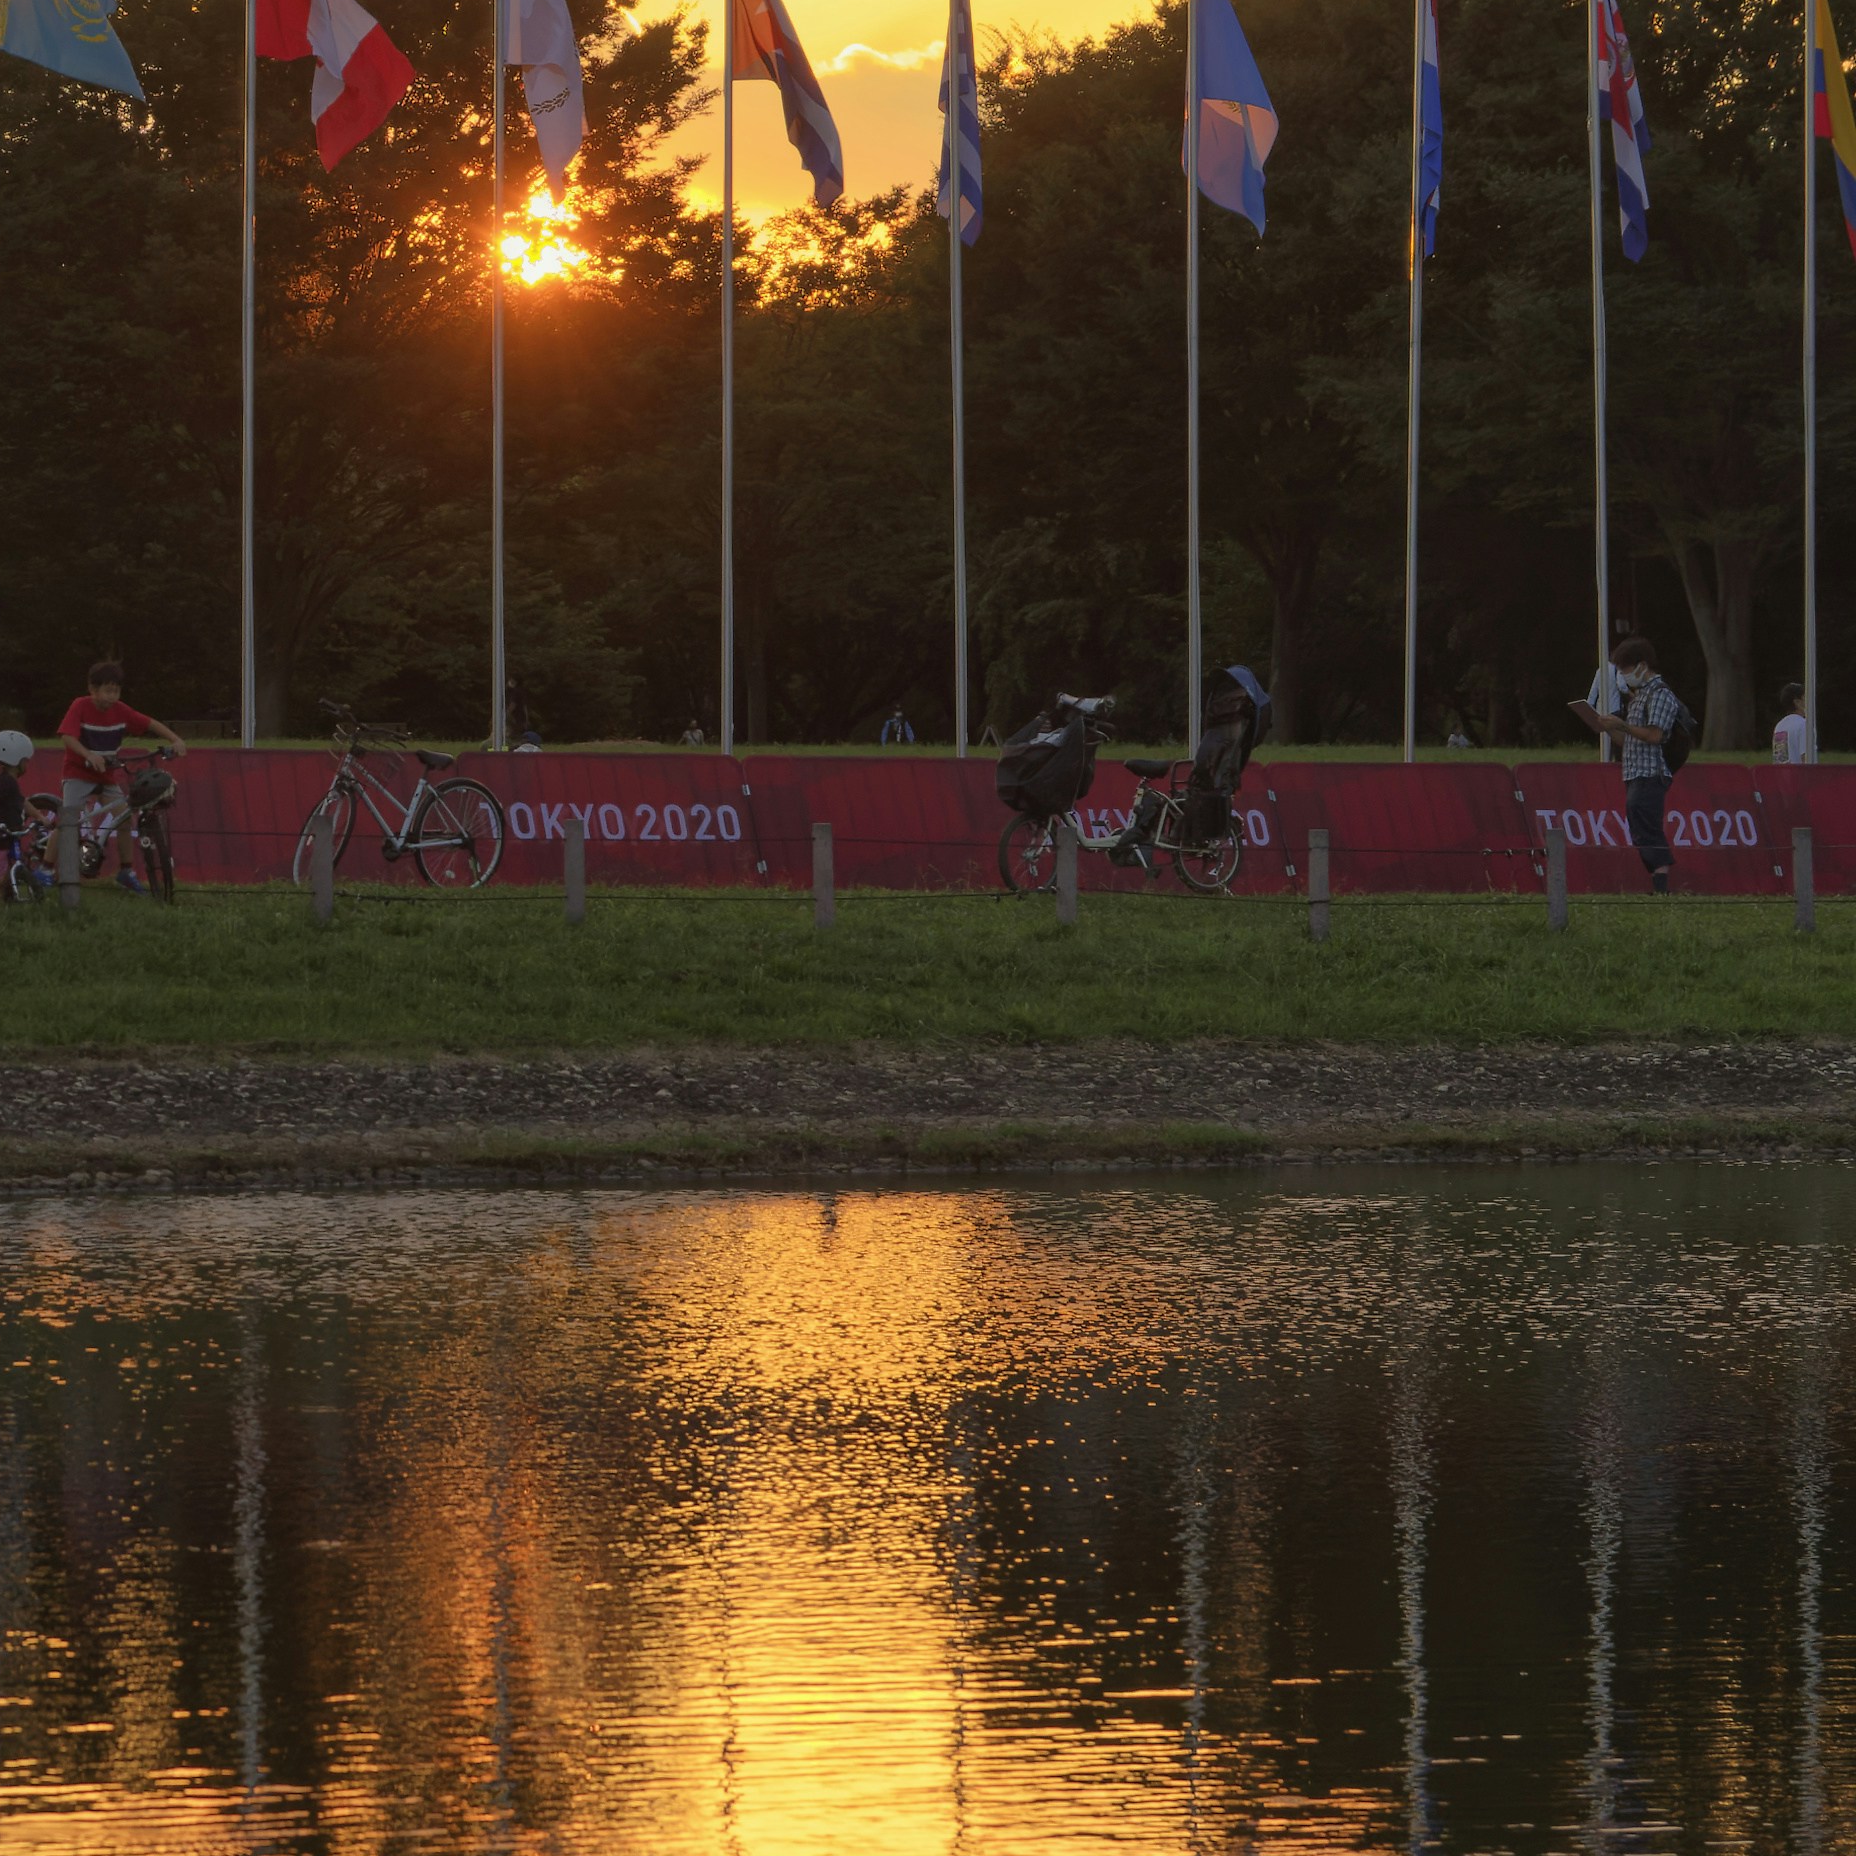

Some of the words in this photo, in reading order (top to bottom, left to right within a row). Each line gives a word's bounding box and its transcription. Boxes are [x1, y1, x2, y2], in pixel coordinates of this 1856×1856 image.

[479, 802, 625, 840] TOKYO
[635, 803, 742, 841] 2020
[1535, 809, 1634, 846] TOKY
[1667, 810, 1758, 846] 2020
